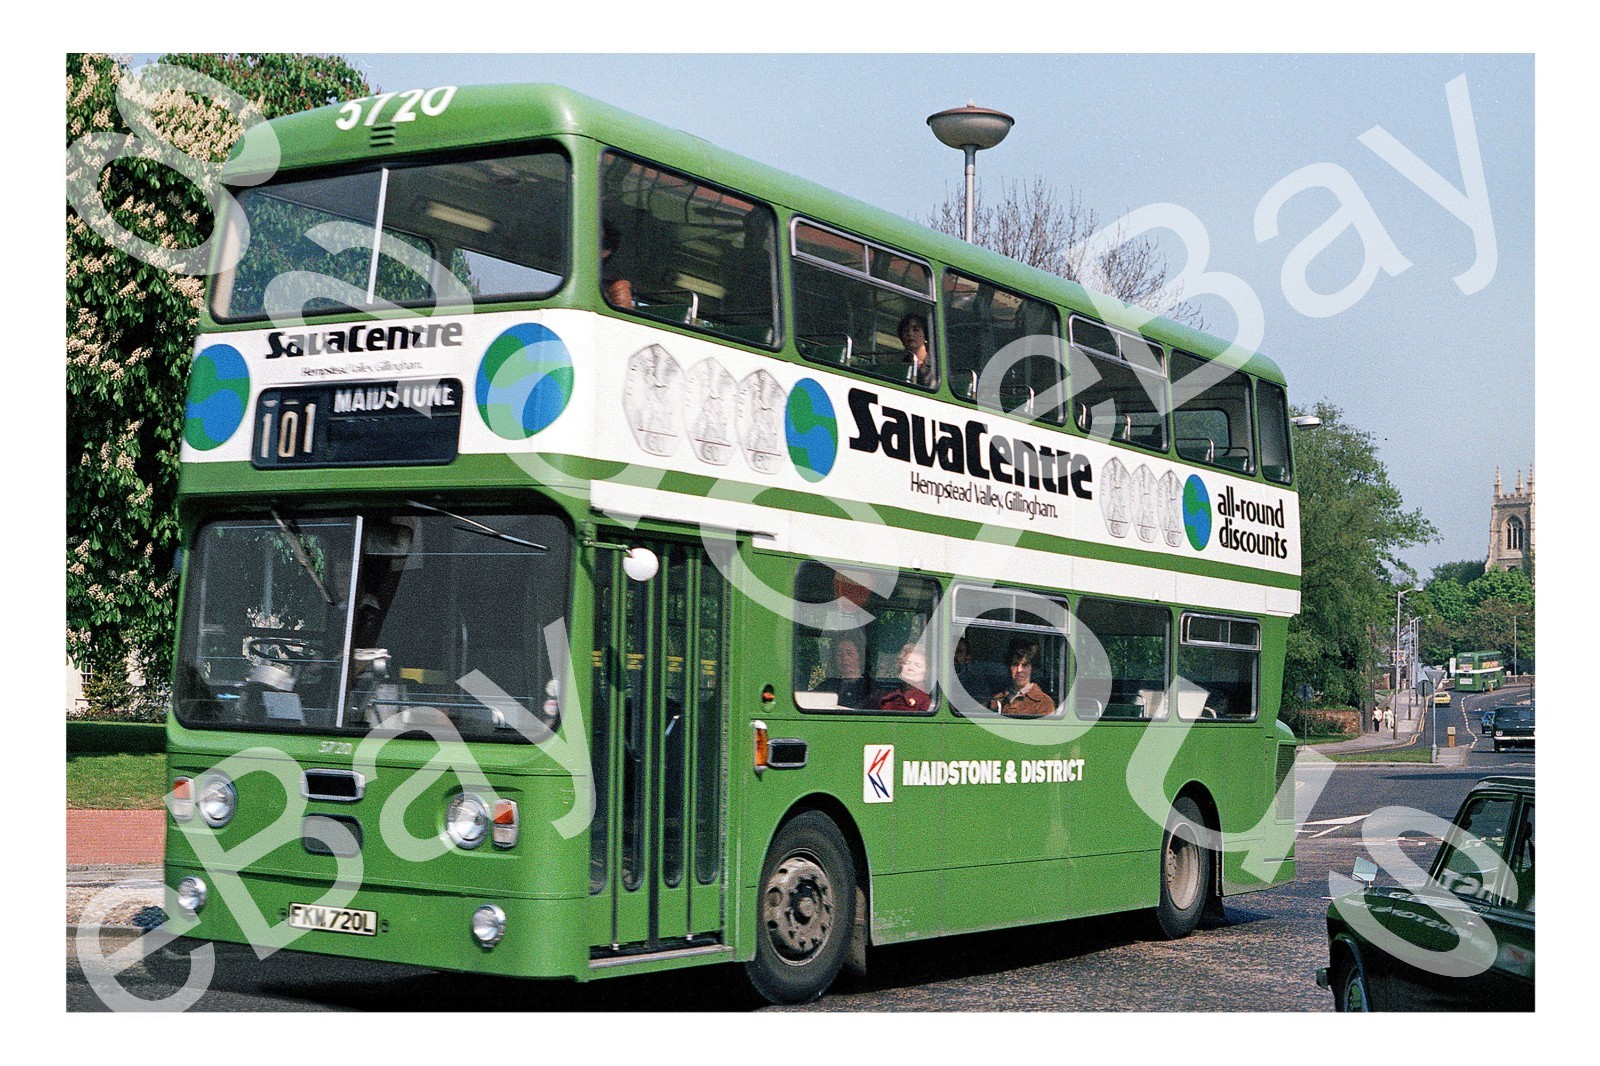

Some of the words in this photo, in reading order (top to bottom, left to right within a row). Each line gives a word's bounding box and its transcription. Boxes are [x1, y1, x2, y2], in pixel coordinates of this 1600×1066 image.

[335, 86, 458, 130] 5720
[266, 322, 463, 359] SavaCentre
[261, 403, 317, 459] 101
[848, 387, 1093, 500] SavaCentre
[910, 471, 972, 504] Hempstead
[1217, 485, 1285, 529] all-round
[1218, 517, 1288, 559] discounts
[902, 760, 1001, 786] MAIDSTONE
[1004, 760, 1018, 784] &
[1021, 759, 1085, 784] DISTRICT
